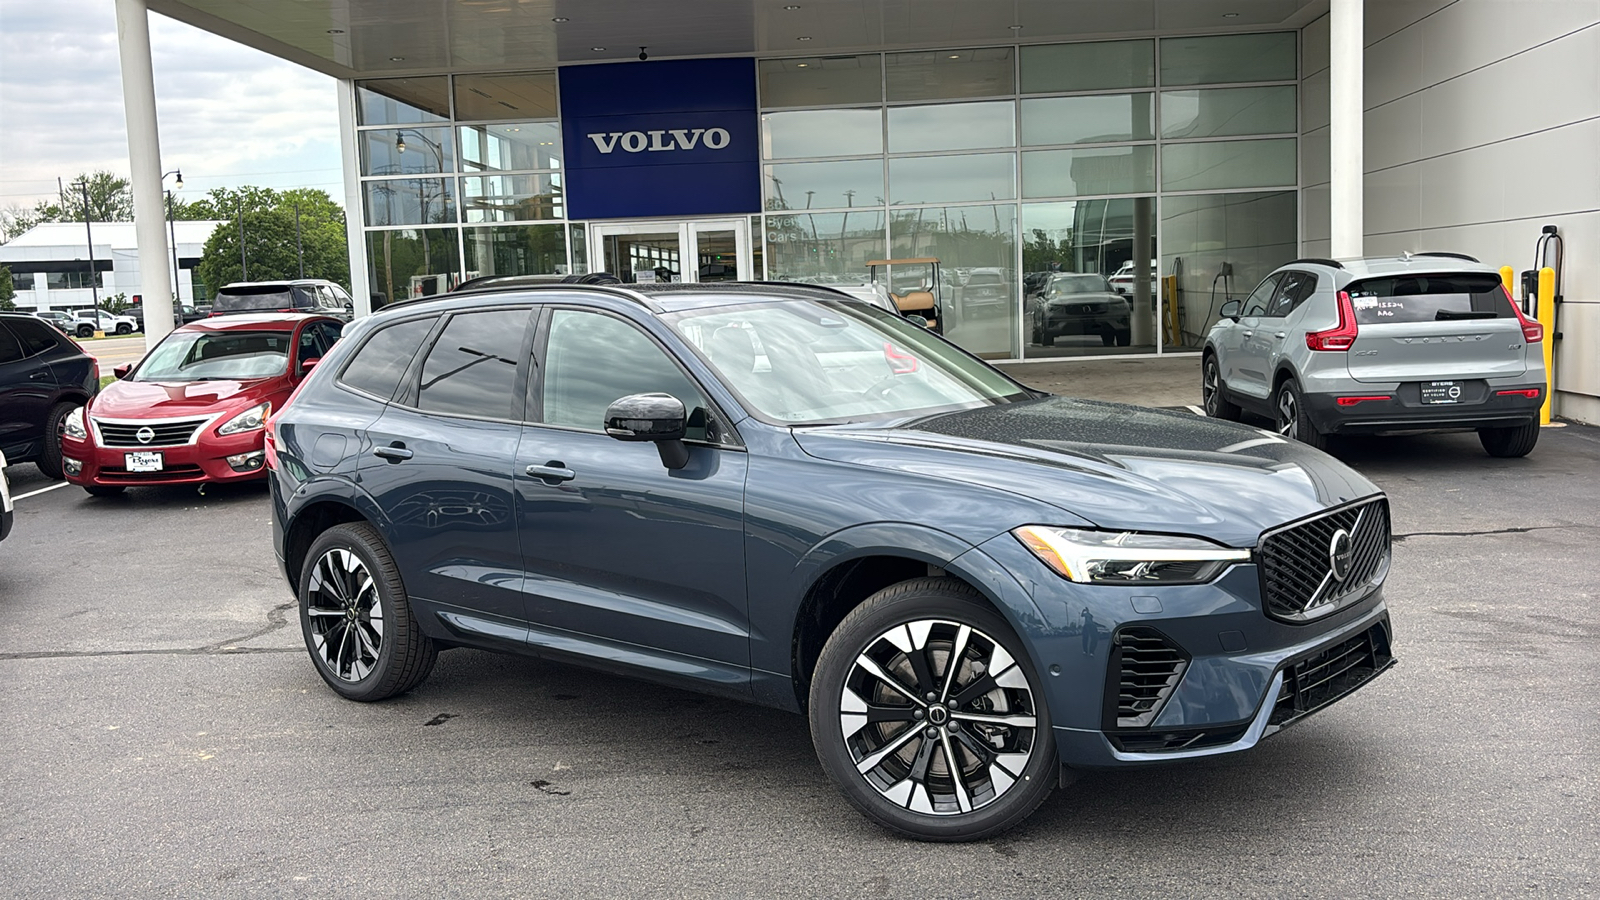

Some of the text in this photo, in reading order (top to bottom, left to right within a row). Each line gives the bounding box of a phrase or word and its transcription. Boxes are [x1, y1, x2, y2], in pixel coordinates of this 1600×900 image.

[587, 127, 731, 154] VOLVO
[768, 231, 797, 243] Cars
[1404, 335, 1482, 344] VOLVO
